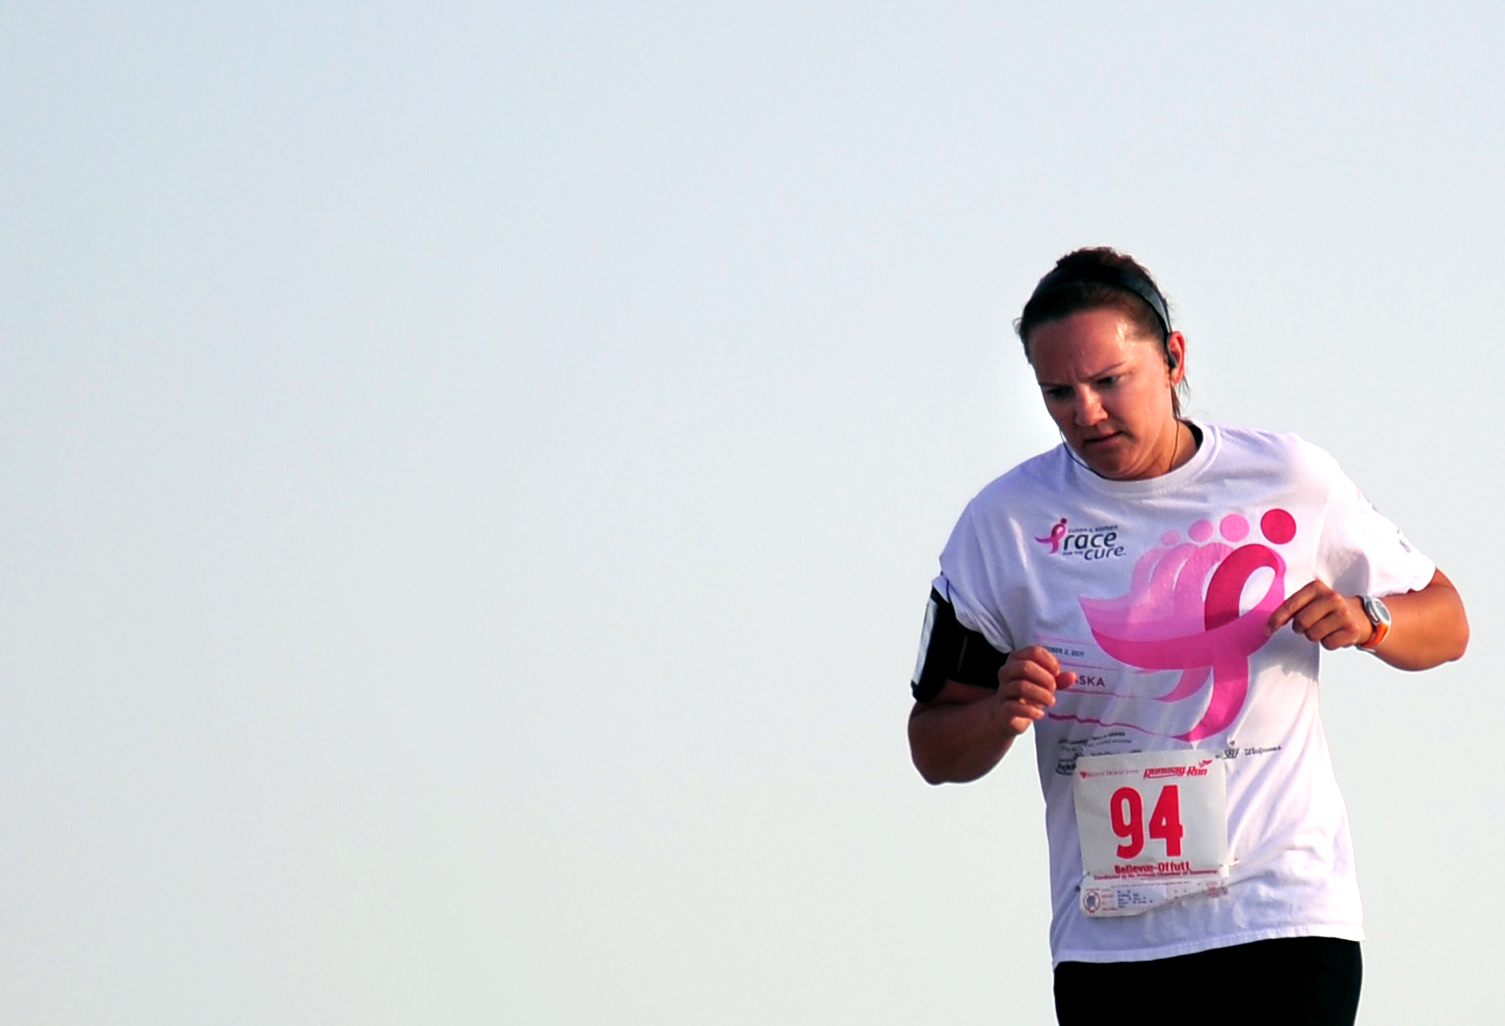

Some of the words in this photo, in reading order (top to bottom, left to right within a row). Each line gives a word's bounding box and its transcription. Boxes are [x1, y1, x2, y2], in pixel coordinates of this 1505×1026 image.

[1063, 532, 1117, 551] race
[1187, 765, 1208, 776] Run
[1110, 784, 1184, 859] 94
